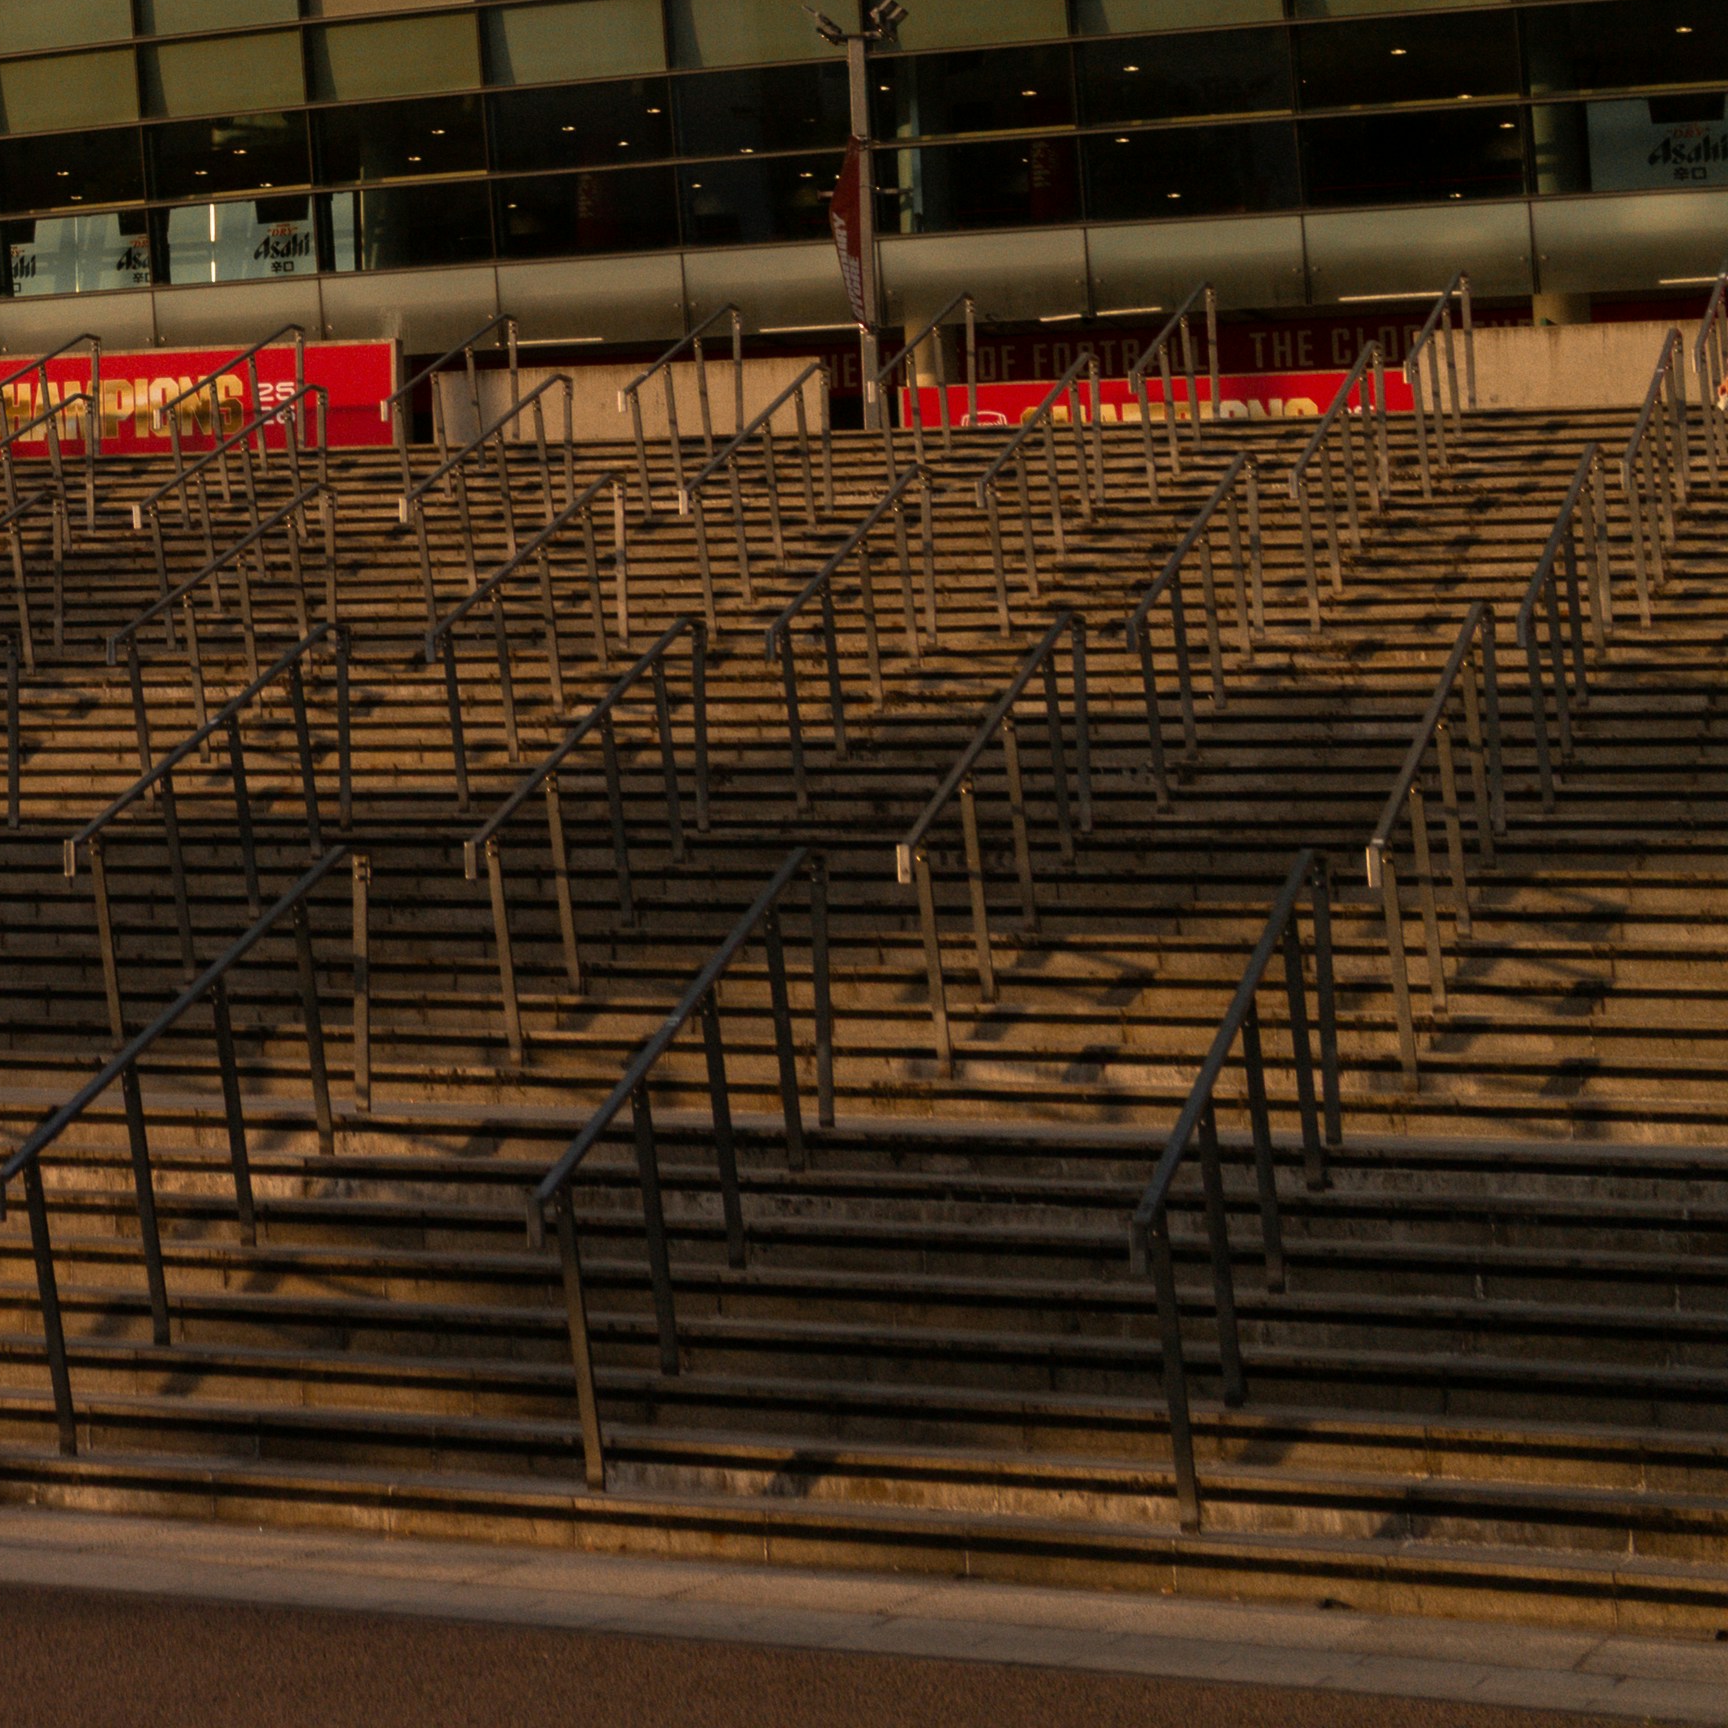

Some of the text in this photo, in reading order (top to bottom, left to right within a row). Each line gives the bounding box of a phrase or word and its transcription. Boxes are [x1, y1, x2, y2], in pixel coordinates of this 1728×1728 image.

[254, 232, 310, 260] Asahi
[977, 344, 1016, 382] OF
[1249, 328, 1315, 369] THE
[258, 381, 296, 401] 25
